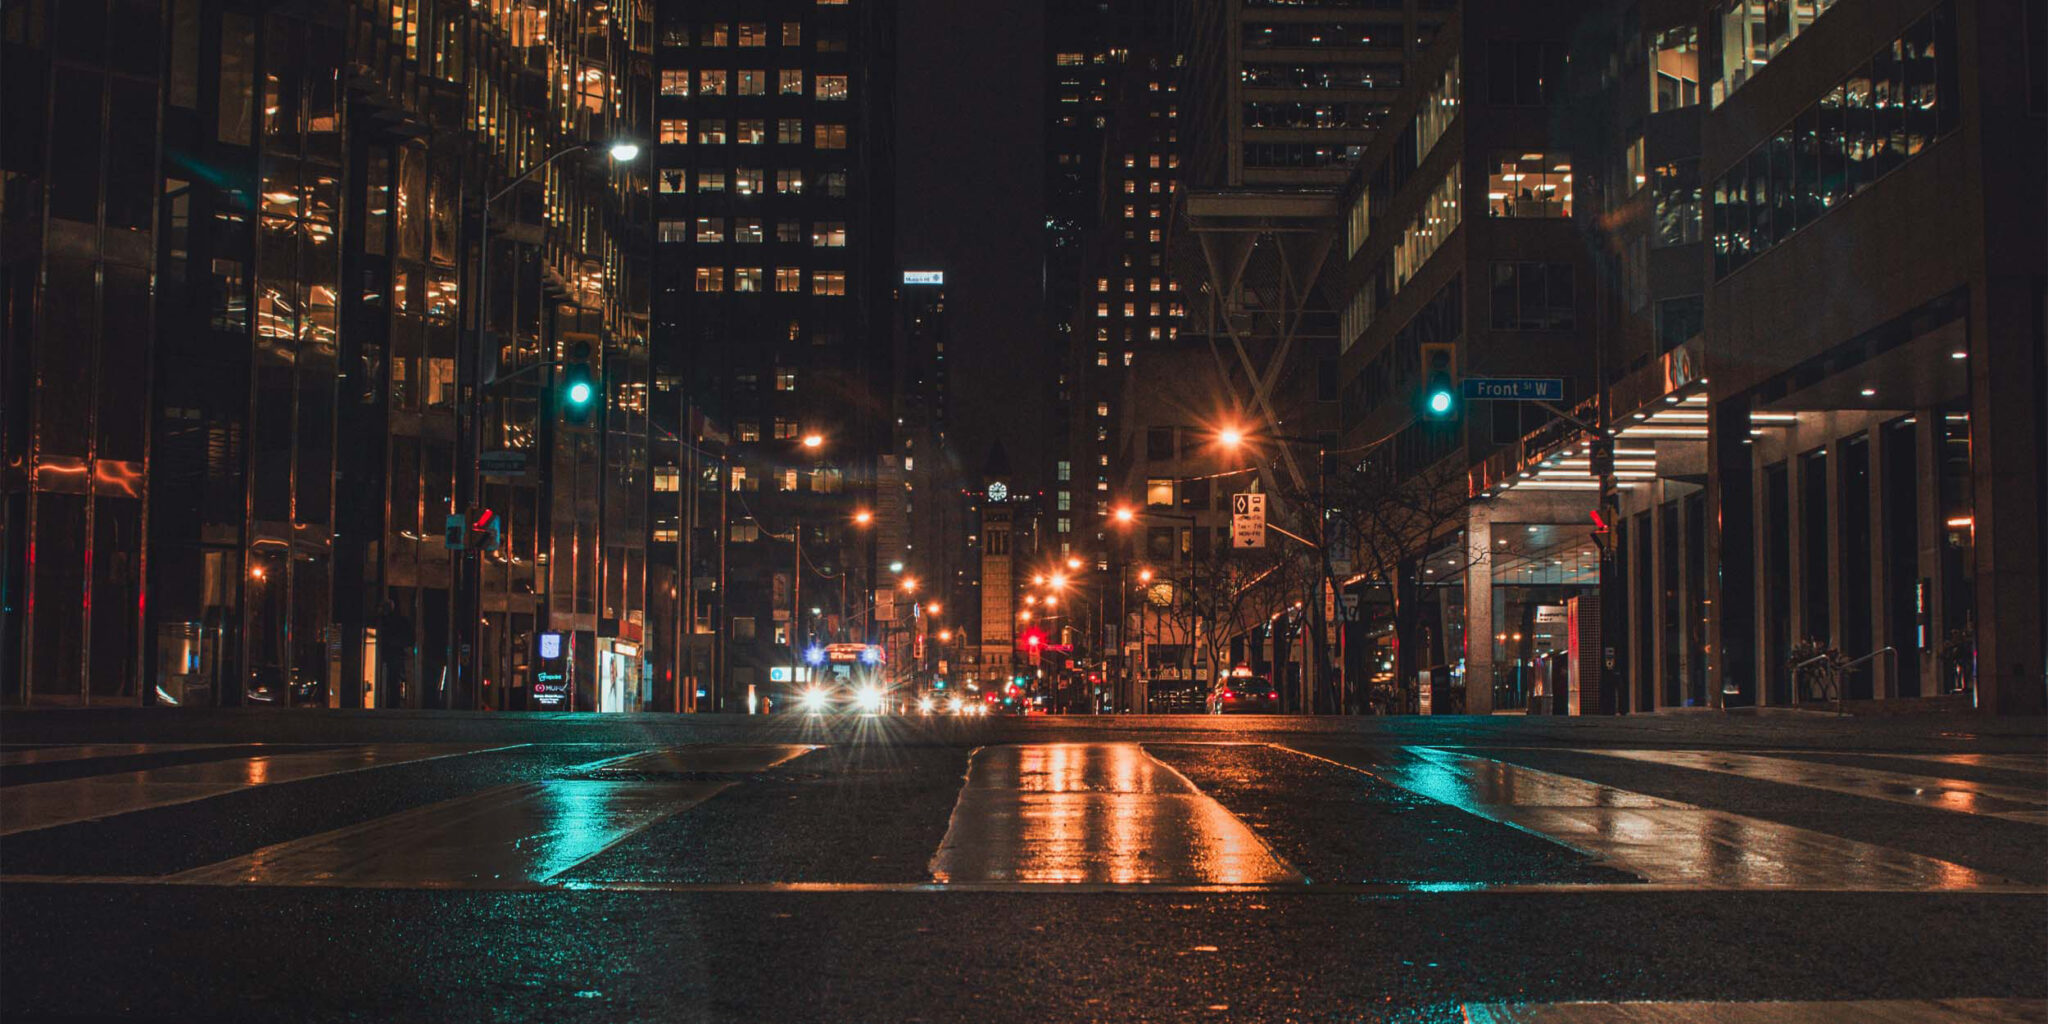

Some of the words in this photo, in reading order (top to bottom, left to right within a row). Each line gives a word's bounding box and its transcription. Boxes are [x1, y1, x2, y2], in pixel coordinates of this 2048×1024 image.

[1477, 381, 1519, 396] Front
[1523, 382, 1532, 390] St
[1535, 381, 1548, 396] W
